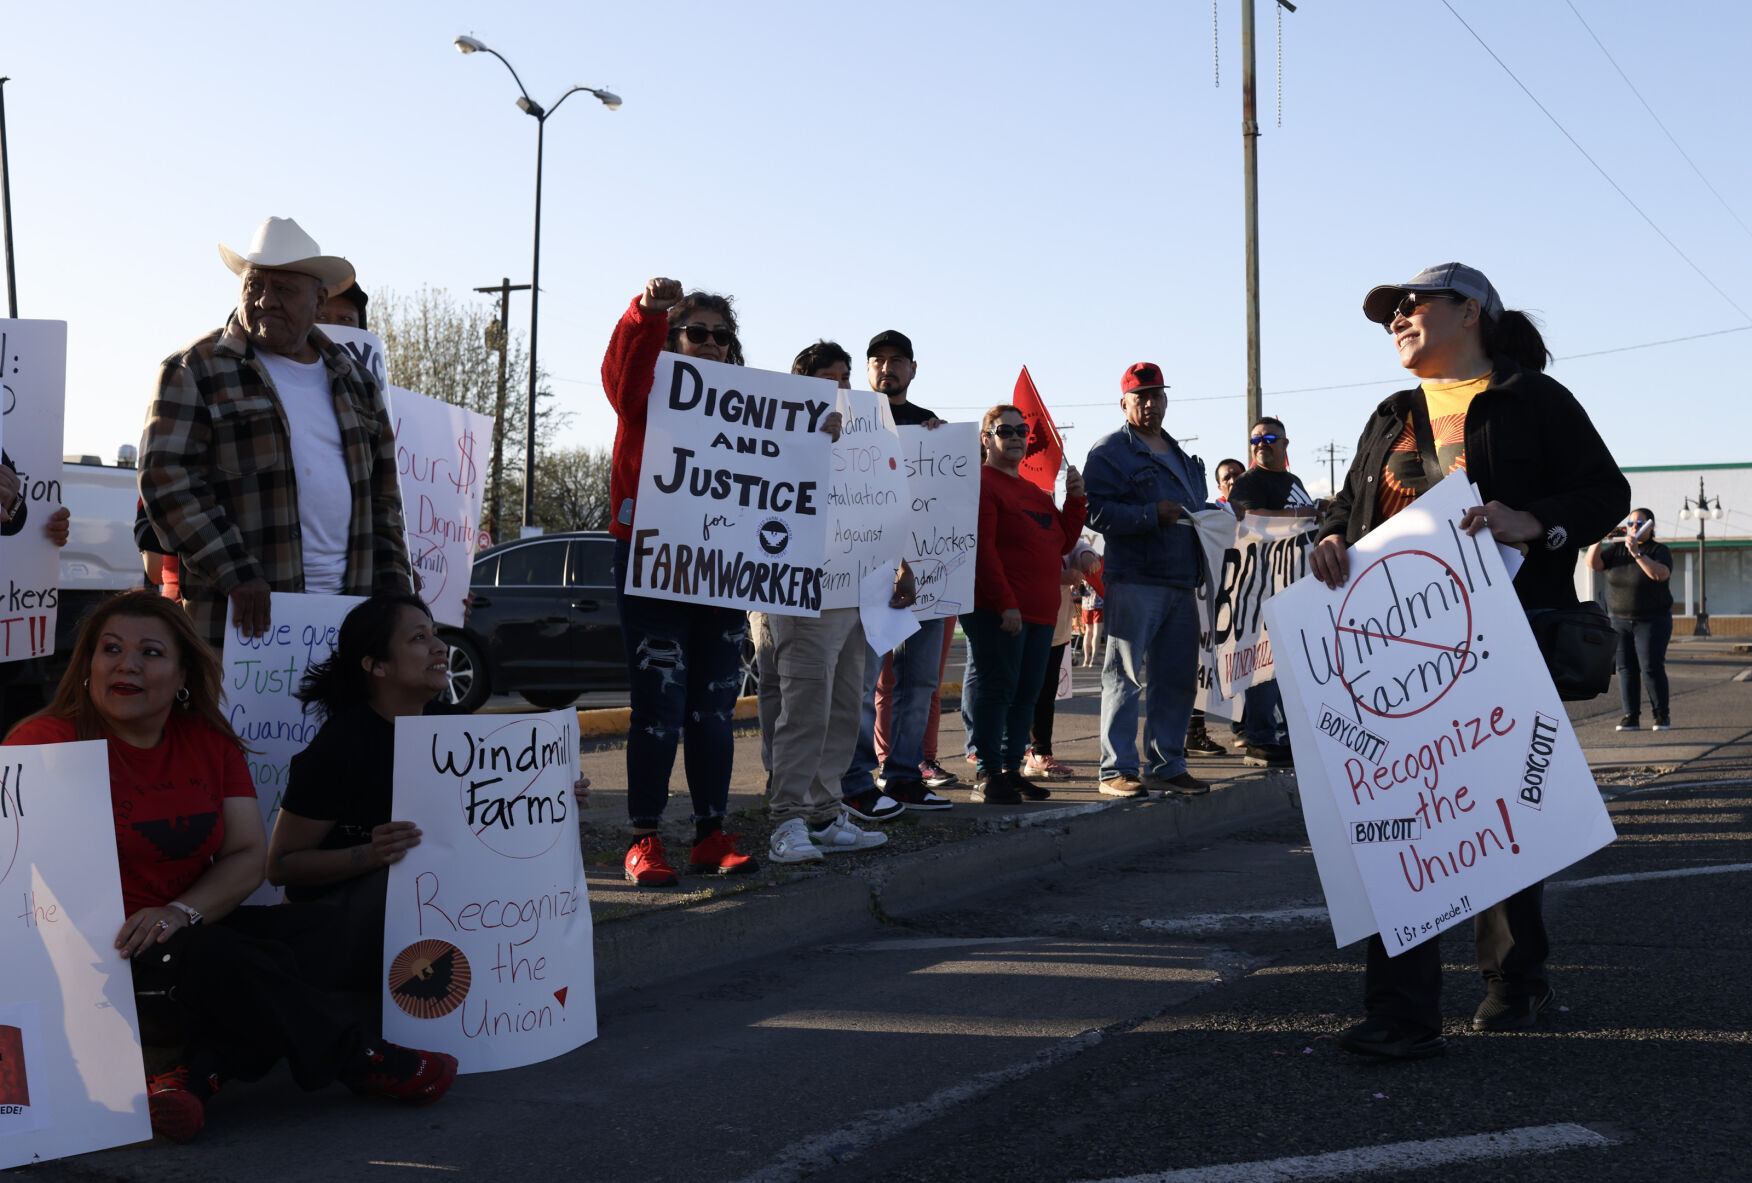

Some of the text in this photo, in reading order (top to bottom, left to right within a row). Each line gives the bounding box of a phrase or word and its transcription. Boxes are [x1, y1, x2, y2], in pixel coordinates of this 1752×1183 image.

[668, 360, 830, 433] DIGNITY
[840, 405, 886, 435] dmill
[710, 432, 780, 458] AND
[831, 445, 882, 477] STOP
[653, 446, 817, 515] JUSTICE
[419, 494, 475, 555] Dignity
[702, 513, 735, 541] for
[835, 519, 882, 553] Against
[911, 525, 976, 557] Workers
[632, 528, 823, 611] FARMWORKERS
[913, 592, 935, 606] rms
[1301, 508, 1491, 685] Windmill
[1347, 634, 1489, 724] Farms:
[431, 723, 571, 777] Windmill
[1320, 711, 1385, 761] BOYCOTT
[1344, 706, 1516, 805] Recognize
[1520, 715, 1557, 804] BOYCOTT
[466, 777, 567, 830] Farms
[1415, 786, 1476, 829] the
[1355, 818, 1417, 842] BOYCOTT
[1399, 798, 1520, 892] Union!
[18, 891, 58, 928] the
[1421, 921, 1433, 934] se
[490, 942, 546, 984] the
[461, 986, 568, 1038] Union!
